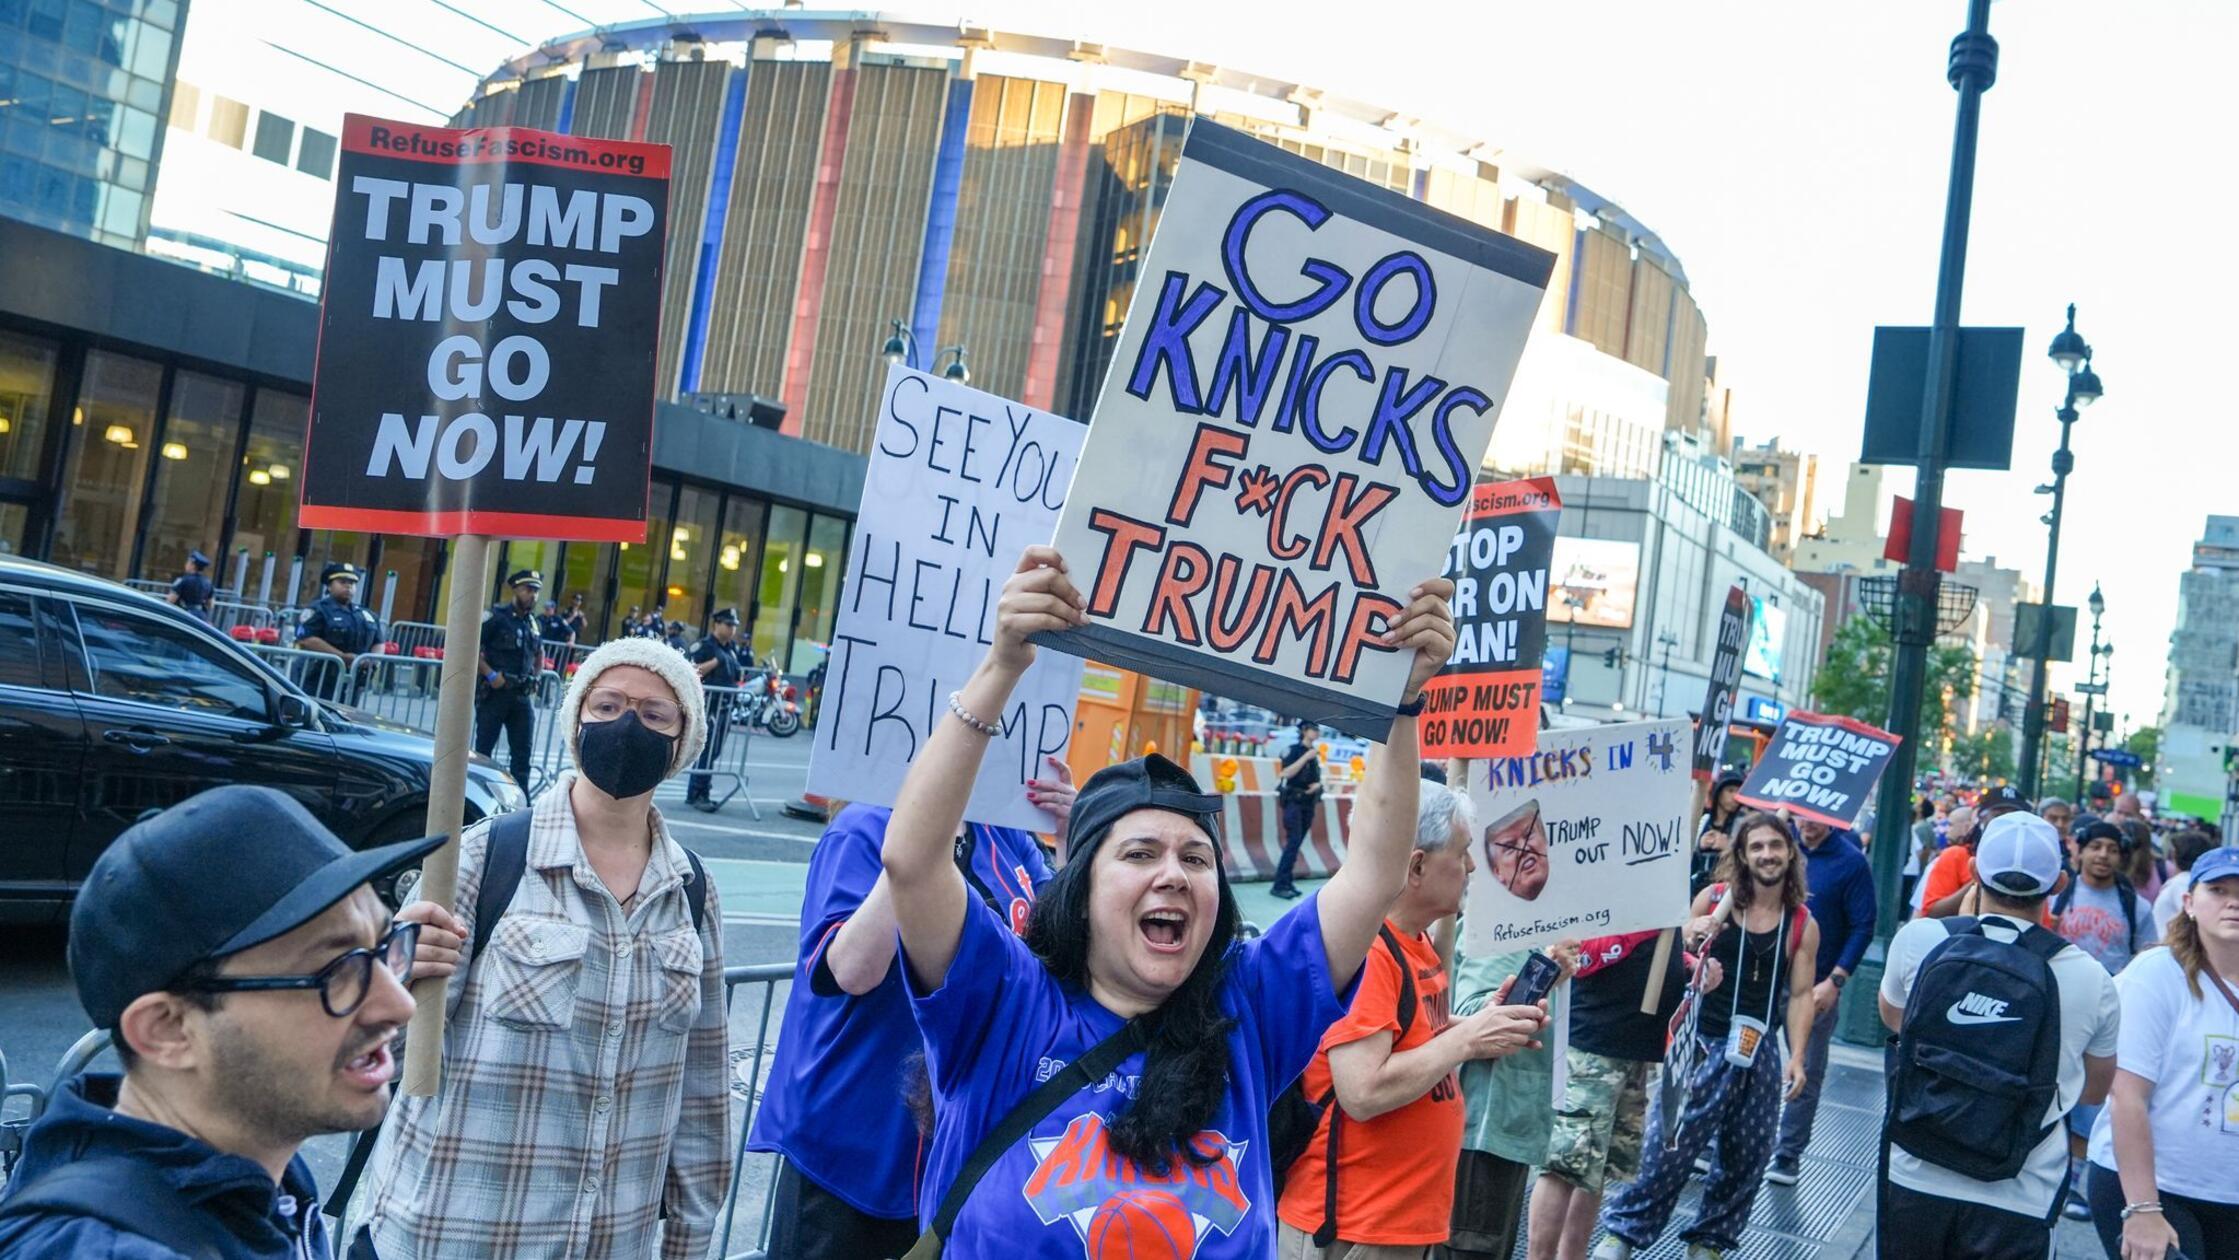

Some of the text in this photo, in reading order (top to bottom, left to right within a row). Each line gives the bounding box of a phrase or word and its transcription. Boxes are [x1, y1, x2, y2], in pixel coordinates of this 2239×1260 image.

[370, 126, 645, 174] RefuseFascism.org
[352, 176, 655, 254] TRUMP
[1221, 188, 1437, 346] GO
[372, 256, 619, 328] MUST
[427, 335, 550, 401] GO
[1126, 270, 1494, 507] KNICKS
[366, 412, 606, 485] NOW!
[880, 376, 991, 484] SEE
[930, 495, 1000, 557] IN
[853, 533, 993, 645] HELL
[1087, 507, 1404, 685] TRUMP
[1488, 569, 1546, 615] ON
[1446, 620, 1519, 666] AN!
[1424, 683, 1536, 715] RUMP MUST
[1424, 718, 1510, 747] GO NOW!
[1785, 721, 1889, 758] TRUMP
[1488, 732, 1674, 791] KNICKS IN 4
[1779, 742, 1871, 774] MUST
[1789, 761, 1836, 785] GO
[1760, 778, 1849, 811] NOW!
[1546, 816, 1601, 846] TRUMP
[1575, 816, 1682, 864] OUT NOW!
[1494, 908, 1610, 941] RefuseFascism.org
[1959, 992, 2009, 1017] NIKE
